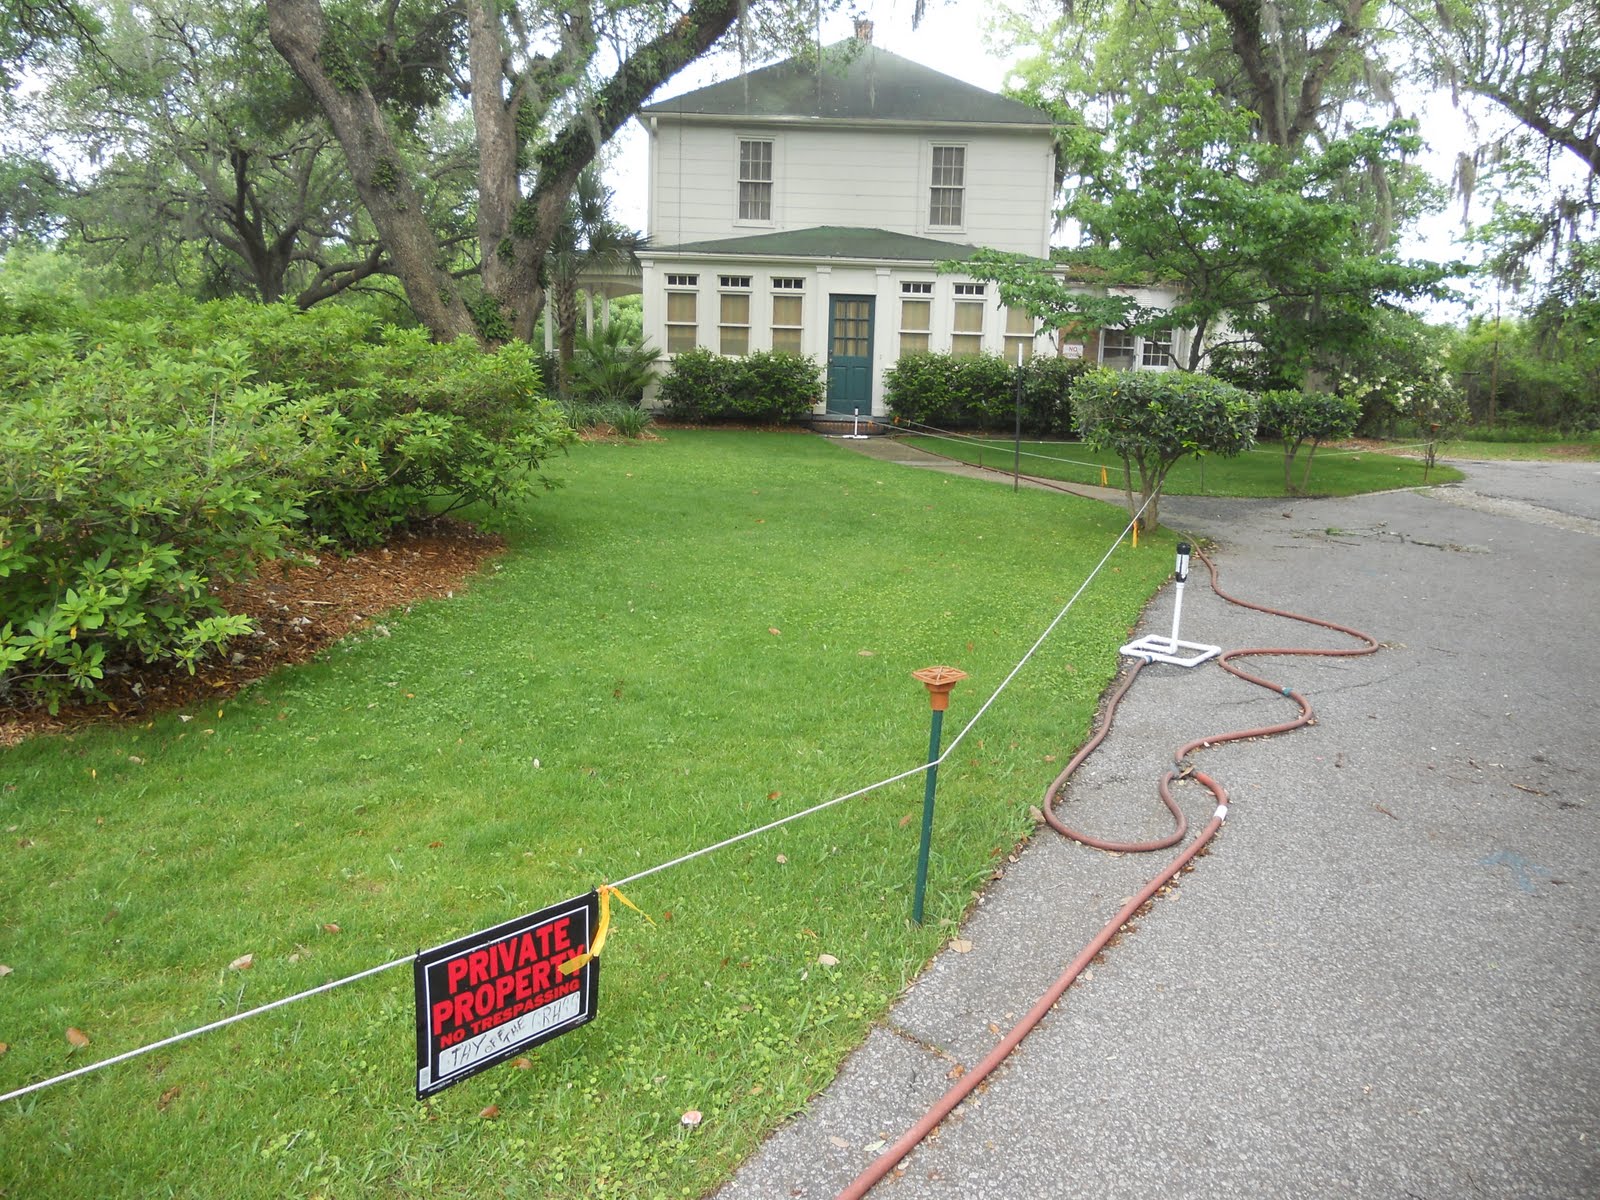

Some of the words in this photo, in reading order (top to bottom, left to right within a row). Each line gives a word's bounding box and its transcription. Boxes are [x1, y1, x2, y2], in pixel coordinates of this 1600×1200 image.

[432, 944, 585, 1036] PROPERTY
[447, 917, 571, 995] PRIVATE
[440, 1028, 465, 1048] NO
[471, 978, 580, 1034] TRESPASSING
